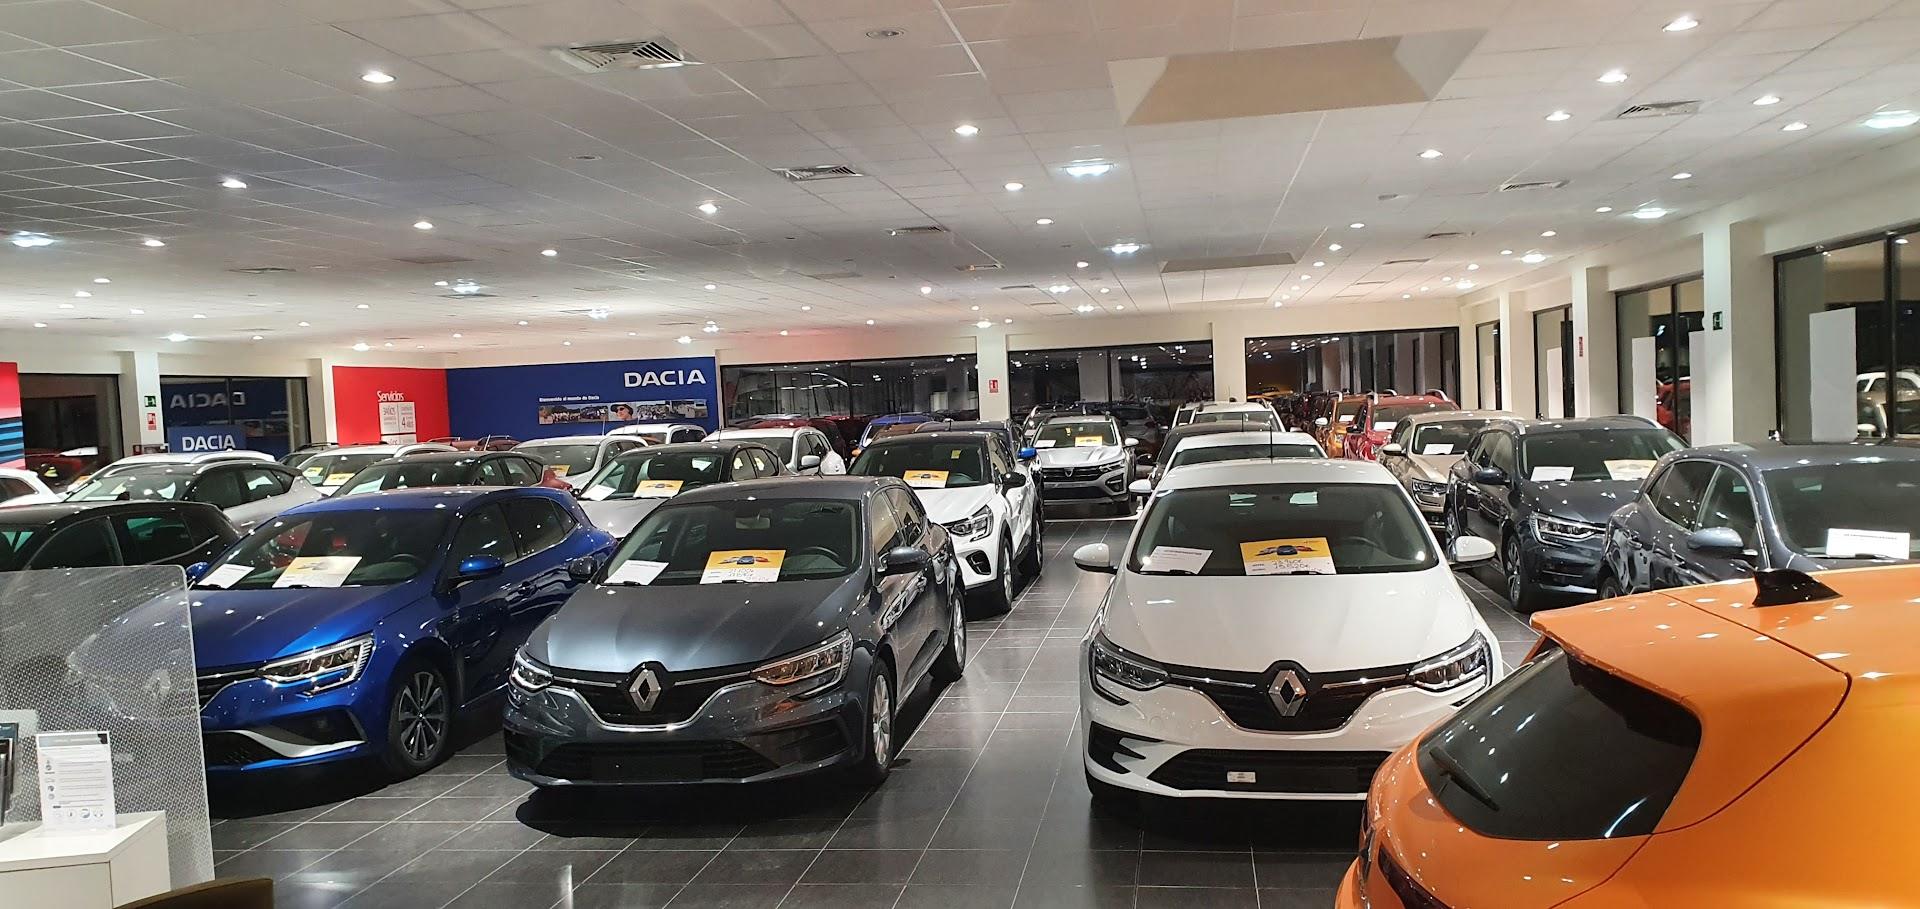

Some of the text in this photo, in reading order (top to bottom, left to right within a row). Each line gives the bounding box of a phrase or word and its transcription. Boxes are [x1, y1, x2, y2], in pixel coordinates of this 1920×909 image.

[624, 369, 706, 388] DACIA
[377, 390, 405, 402] Servicios
[182, 434, 236, 452] DACIA
